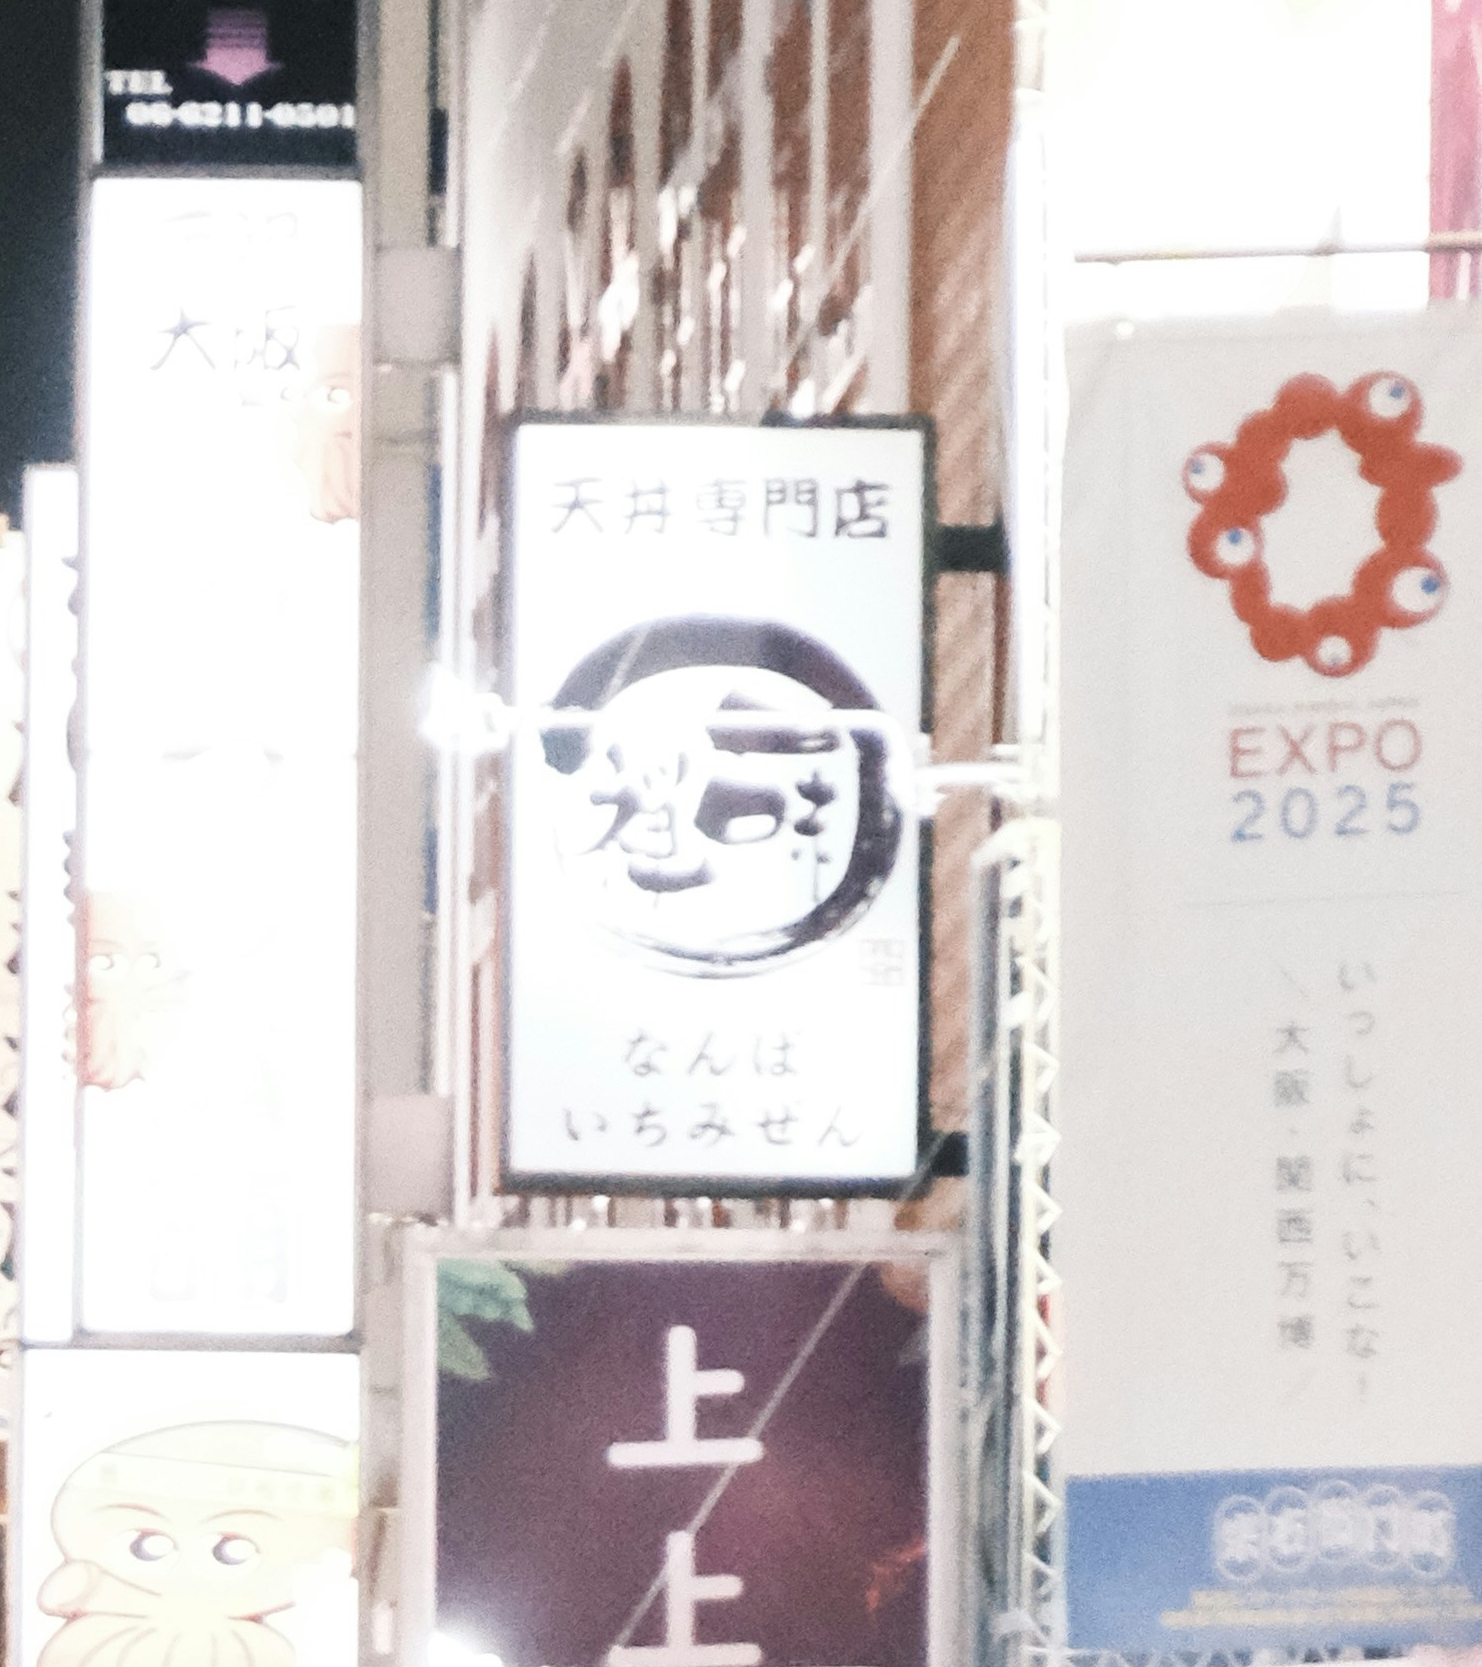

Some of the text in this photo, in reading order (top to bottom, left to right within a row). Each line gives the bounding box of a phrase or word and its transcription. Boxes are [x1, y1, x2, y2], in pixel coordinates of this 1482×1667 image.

[551, 476, 895, 540] 天丼専門店
[1228, 718, 1424, 779] EXPO
[1231, 782, 1422, 843] 2025
[621, 1028, 802, 1081] なんば
[561, 1104, 861, 1151] いちみぜん
